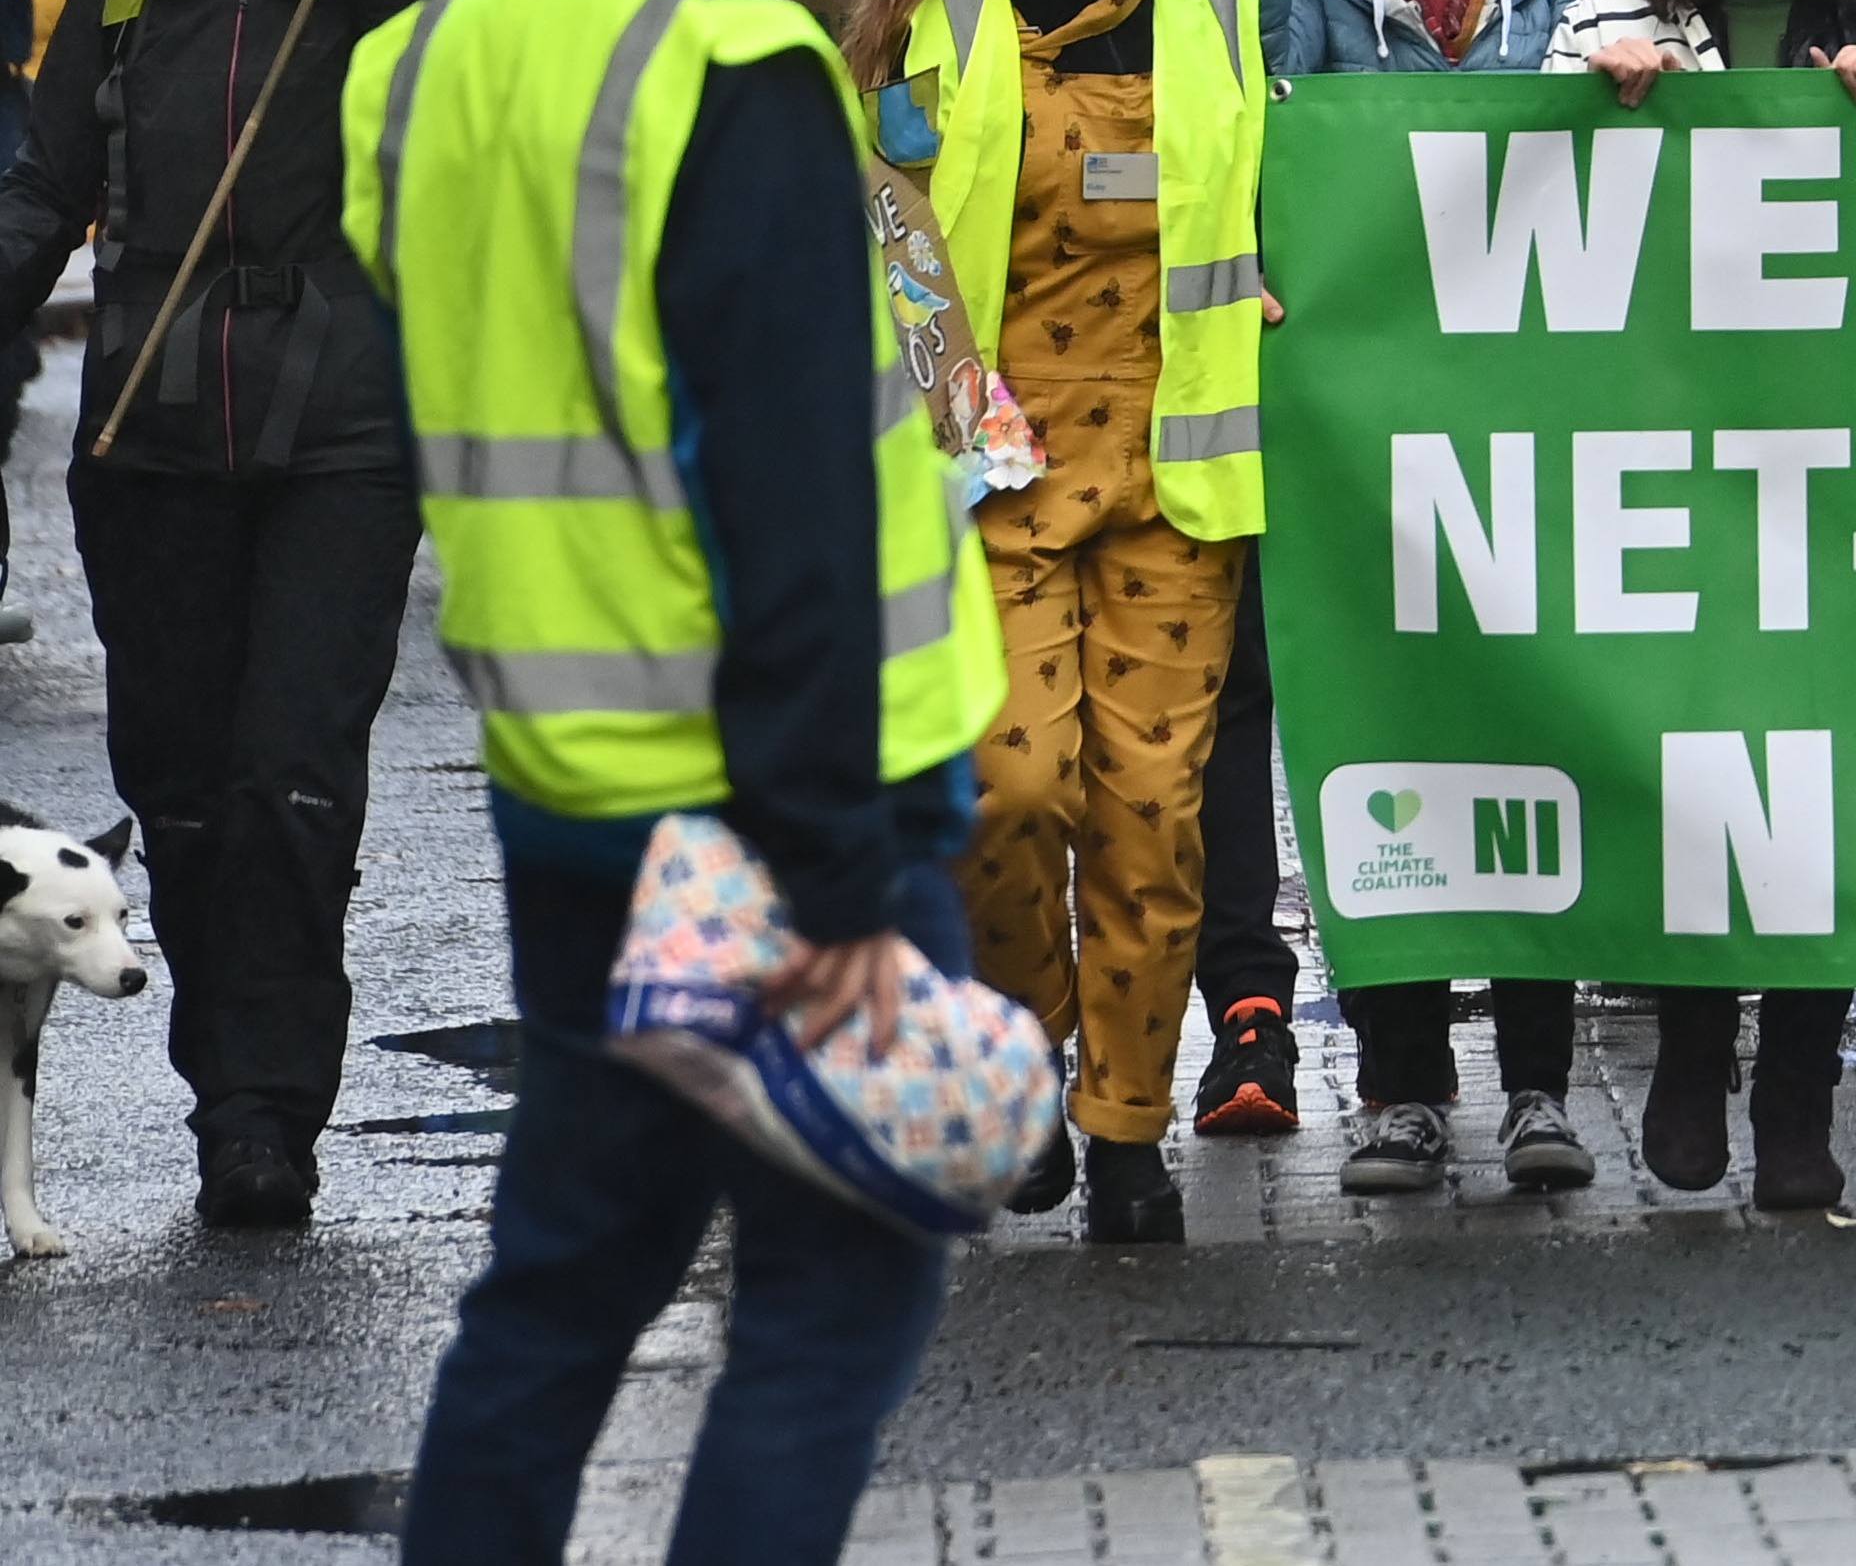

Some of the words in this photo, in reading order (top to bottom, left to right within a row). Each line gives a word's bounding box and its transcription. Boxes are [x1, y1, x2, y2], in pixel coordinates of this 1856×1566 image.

[1408, 126, 1849, 334] WE
[1473, 796, 1562, 877] NI
[1376, 842, 1414, 857] THE
[1357, 857, 1436, 875] CLIMATE
[1351, 872, 1449, 893] COALITION
